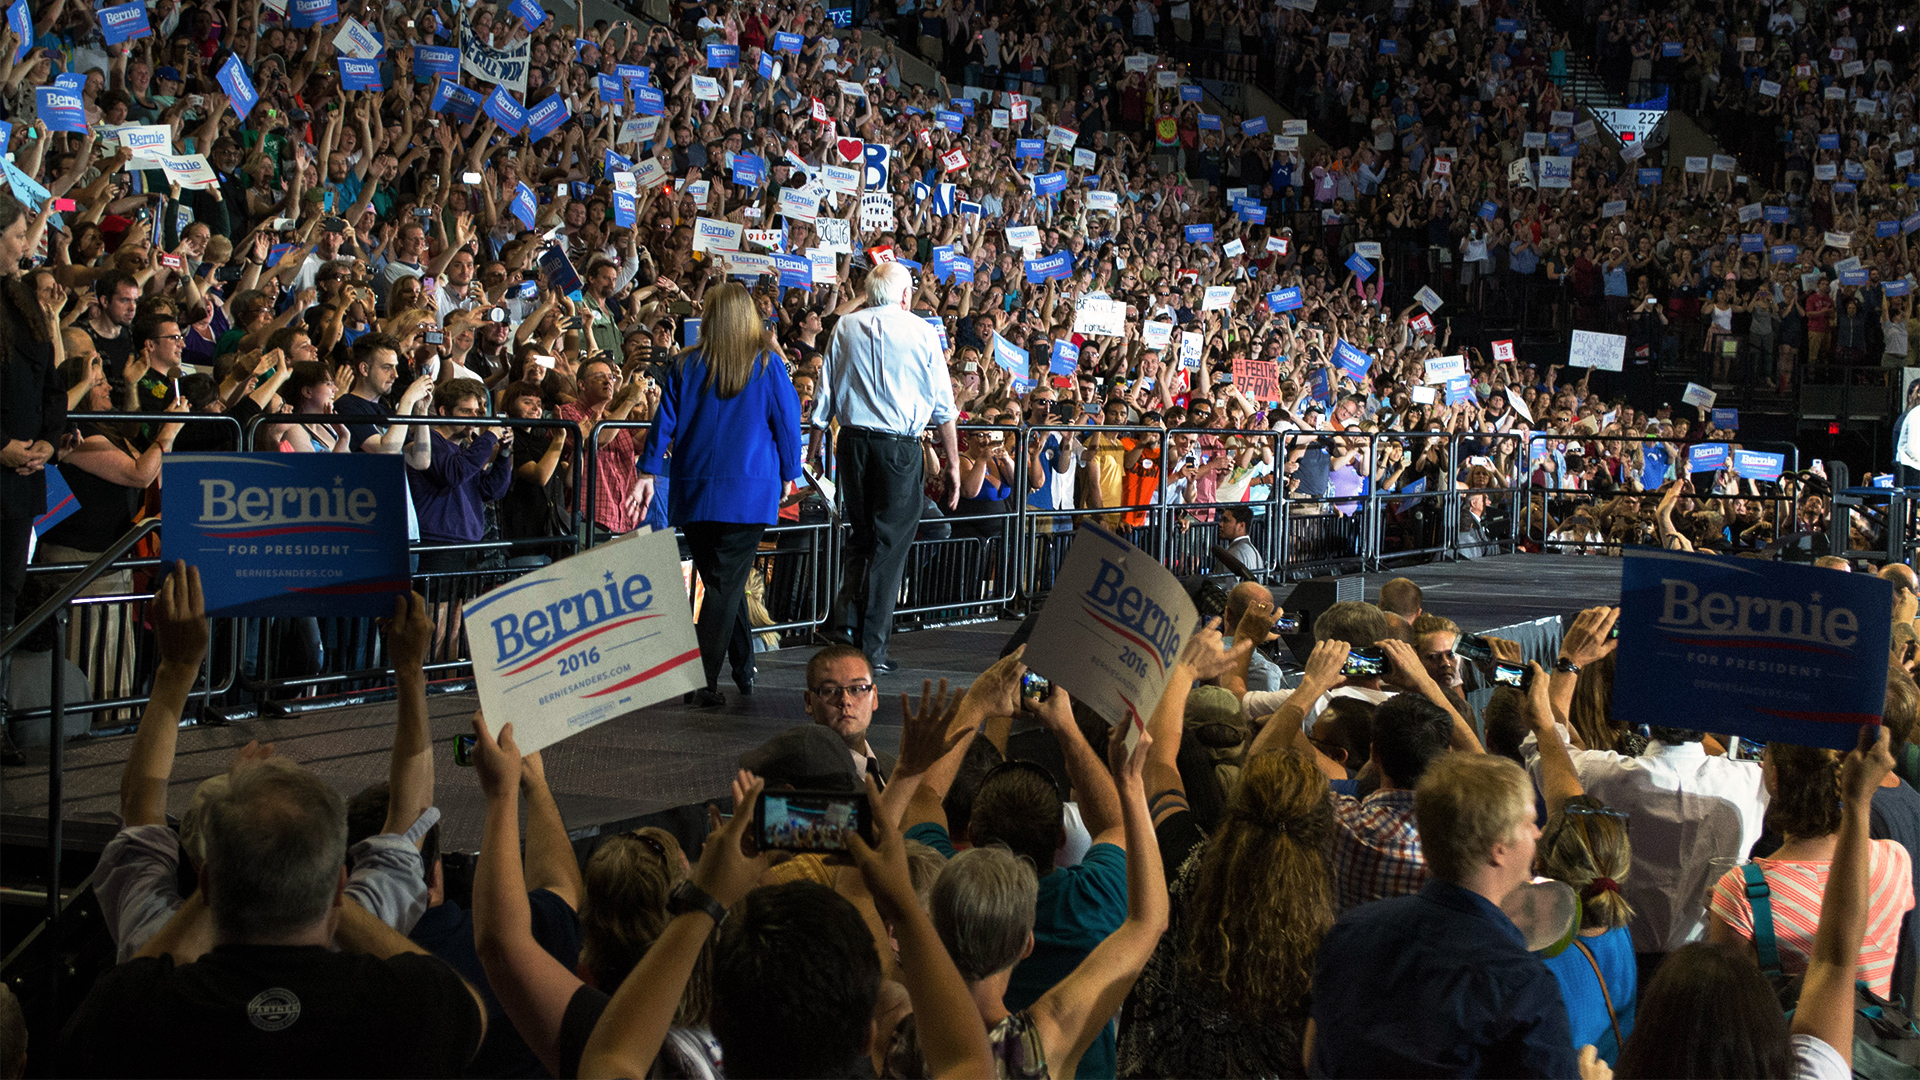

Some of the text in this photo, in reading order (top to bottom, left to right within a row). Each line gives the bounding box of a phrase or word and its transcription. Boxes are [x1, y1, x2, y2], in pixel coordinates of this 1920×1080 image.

[106, 7, 141, 24] Bernie
[349, 26, 375, 52] Bernie
[420, 49, 454, 61] Bernie
[711, 47, 736, 57] Bernie
[345, 62, 375, 73] Bernie
[498, 60, 525, 81] WIN
[618, 67, 646, 79] Bernie
[231, 63, 252, 101] Bernie
[444, 86, 475, 105] Bernie
[639, 89, 661, 102] Bernie
[1222, 84, 1240, 97] 221
[47, 92, 82, 109] Bernie
[495, 91, 521, 119] Bernie
[528, 101, 558, 123] Bernie
[627, 120, 655, 131] Bernie
[100, 129, 119, 141] Ber
[128, 132, 165, 145] Bernie
[1020, 141, 1042, 150] Bernie
[163, 157, 201, 170] Bernie
[1545, 161, 1571, 178] Bernie
[634, 164, 653, 178] rnie
[828, 169, 855, 181] Bernie
[1039, 174, 1062, 186] Bernie
[688, 183, 706, 193] ernie
[618, 197, 635, 209] Bern
[785, 194, 815, 207] Bernie
[863, 193, 893, 206] FEELING
[868, 206, 885, 215] THE
[700, 223, 735, 238] Bernie
[1010, 229, 1035, 237] Bernie
[732, 255, 769, 265] Bernie
[811, 254, 833, 264] Bernie
[940, 250, 953, 260] Ber
[777, 258, 808, 272] Bernie
[953, 262, 971, 272] ernie
[1031, 258, 1064, 271] Bernie
[1271, 291, 1296, 301] Bernie
[1060, 346, 1078, 360] Bern
[1339, 345, 1365, 366] Bernie
[1430, 360, 1458, 371] Bernie
[1015, 382, 1034, 392] Bern
[1694, 446, 1723, 457] Bernie
[1741, 454, 1777, 467] Bernie
[199, 475, 377, 524] Bernie
[228, 545, 349, 555] FOR PRESIDENT
[236, 569, 343, 578] BERNIESANDERS.COM
[491, 570, 653, 664] Bernie
[1086, 558, 1181, 669] Bernie
[1658, 578, 1858, 648] Bernie
[557, 647, 600, 677] 2016
[1119, 646, 1148, 678] 2016
[1687, 652, 1822, 678] FOR PRESIDENT
[538, 664, 631, 705] BERNIESANDERS.COM
